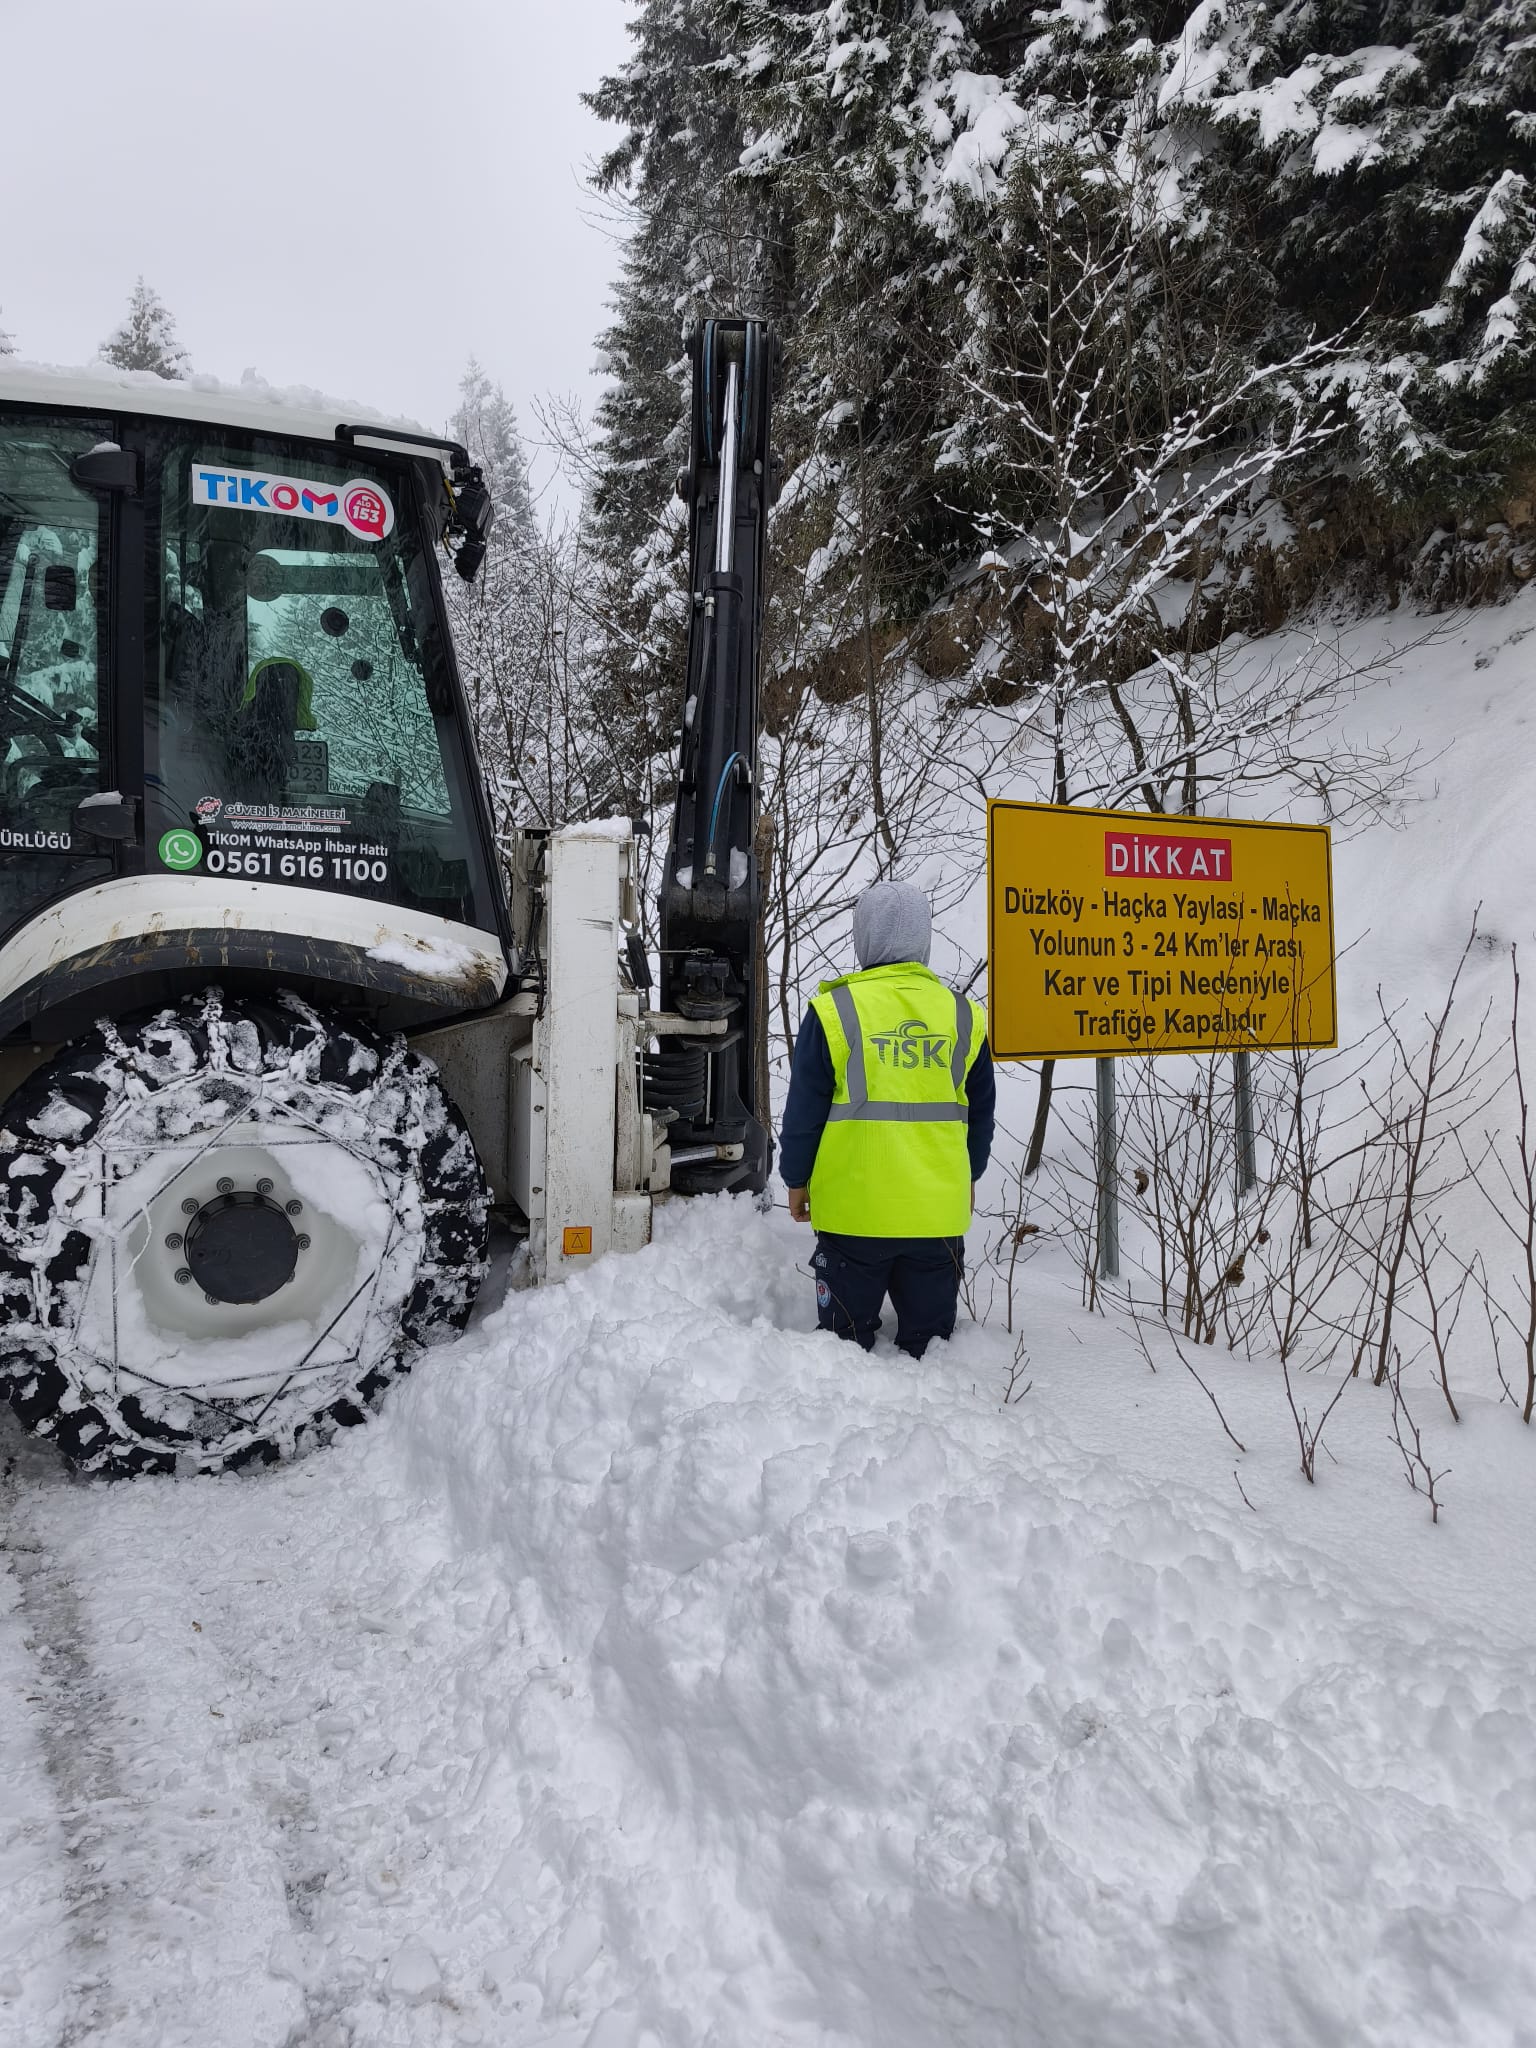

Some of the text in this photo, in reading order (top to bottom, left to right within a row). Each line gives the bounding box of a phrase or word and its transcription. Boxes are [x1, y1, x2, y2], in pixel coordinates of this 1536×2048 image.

[352, 505, 380, 523] 153
[225, 802, 345, 820] GÜVEN İŞ MAKİNELERİ
[207, 830, 388, 857] TİKOM WhatsApp İhbar Hattı
[1111, 837, 1226, 877] DİKKAT
[206, 850, 387, 882] 0561 616 1100
[1005, 886, 1084, 923] Düzköy
[1104, 891, 1167, 924] Haçka
[1173, 893, 1244, 926] Yaylası
[1263, 896, 1321, 928] Maçka
[1029, 929, 1116, 956] Yolunun
[1122, 931, 1134, 956] 3
[1154, 931, 1178, 957] 24
[1254, 933, 1302, 958] Arası
[1044, 969, 1290, 1002] Kar ve Tipi Nedeniyle
[1074, 1007, 1267, 1041] Trafiğe Kapalıdır
